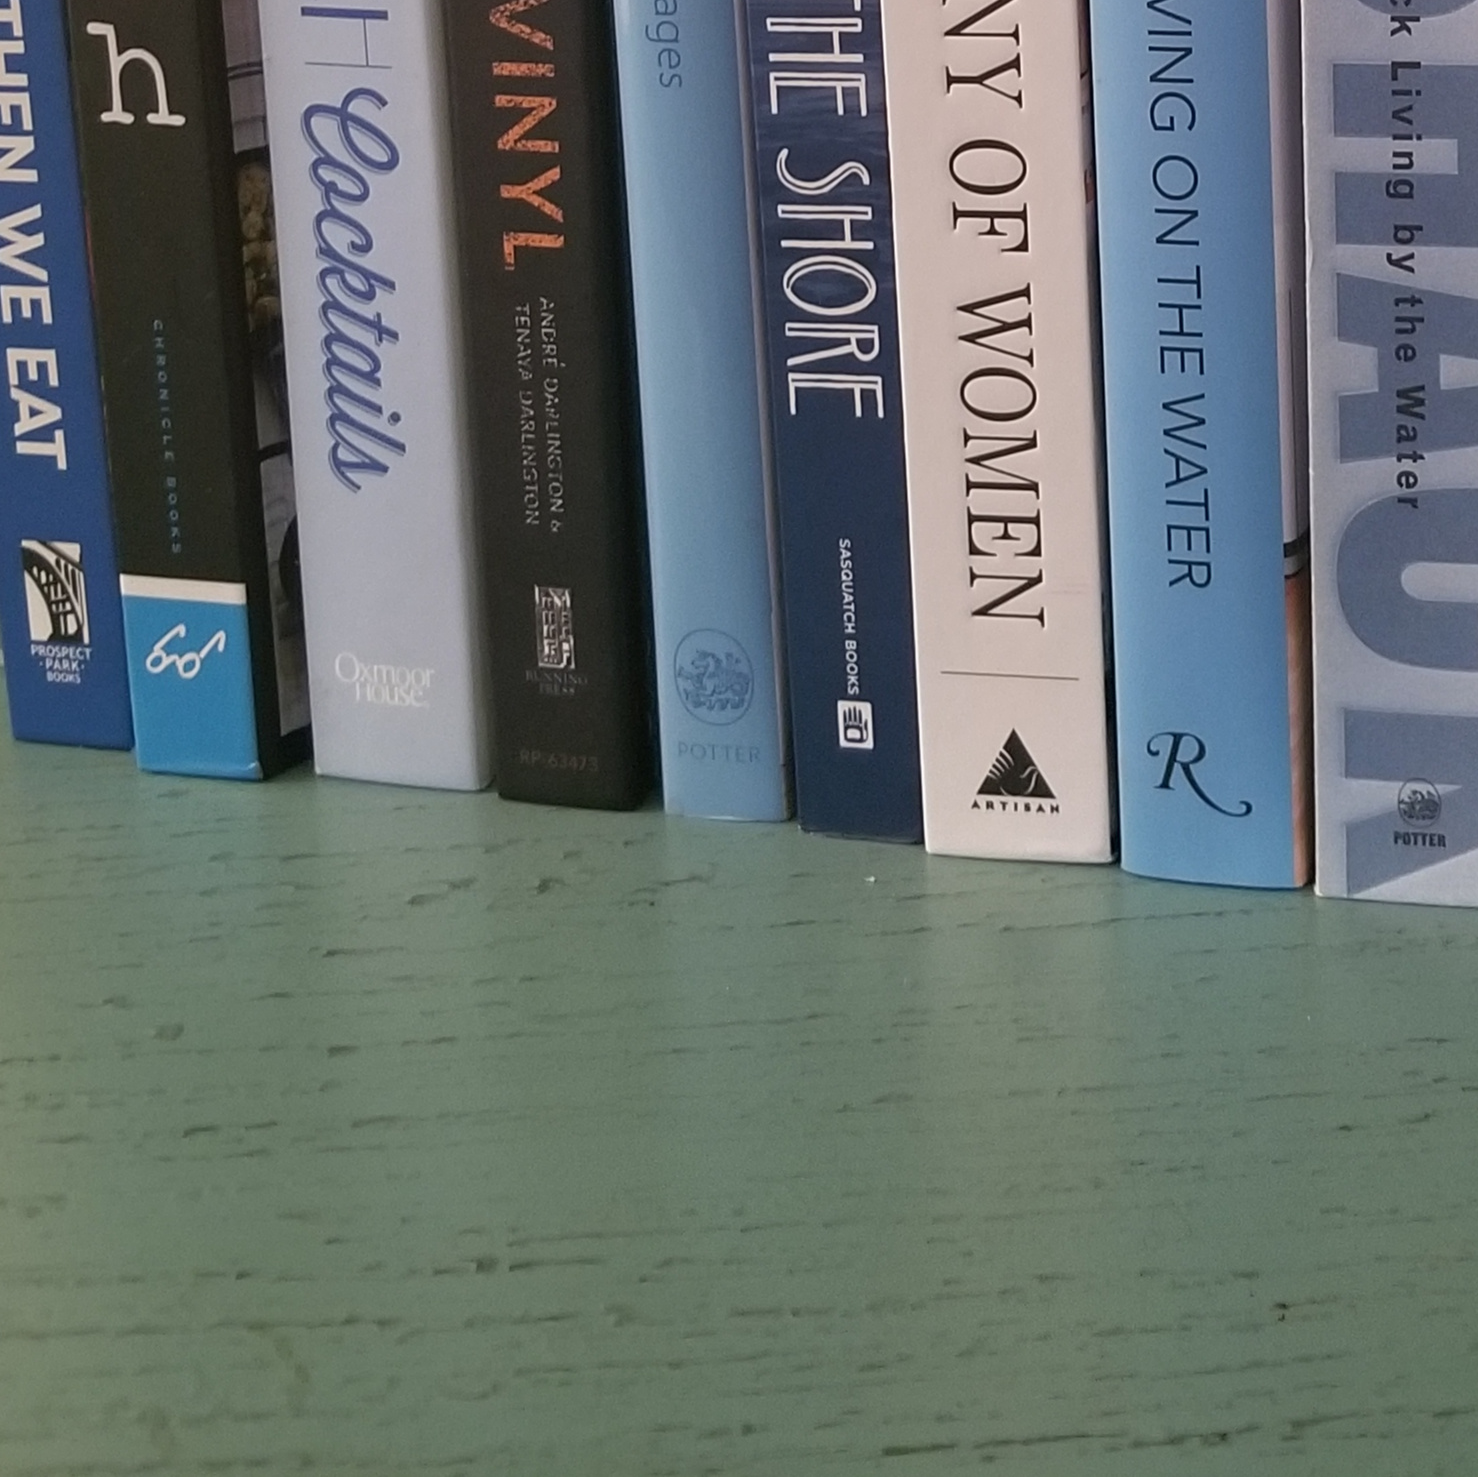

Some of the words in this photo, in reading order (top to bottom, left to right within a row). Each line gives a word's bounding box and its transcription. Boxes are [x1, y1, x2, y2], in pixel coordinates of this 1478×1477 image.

[1385, 59, 1423, 201] Living
[948, 138, 1030, 254] OF
[1152, 154, 1200, 247] ON
[301, 86, 407, 494] Cocktails
[775, 147, 884, 420] SHORE
[1385, 222, 1424, 275] by
[515, 302, 533, 381] TENAYA
[1156, 265, 1206, 376] THE
[1393, 294, 1426, 364] the
[5, 346, 68, 472] EAT
[152, 319, 176, 460] CHRONICLE
[165, 476, 182, 554] BOOKS
[955, 282, 1046, 629] WOMEN
[1395, 385, 1427, 510] Water
[519, 390, 540, 526] DARLINGTON
[1161, 392, 1213, 590] WATER
[838, 537, 856, 634] SASQUATCH
[30, 643, 93, 661] PROSPECT
[46, 670, 81, 685] BOOKS
[334, 651, 436, 689] Oxmoor
[844, 639, 860, 696] BOOKS
[676, 740, 762, 764] POTTER
[970, 797, 1062, 815] ARTISAN
[1393, 830, 1447, 849] POTTER
